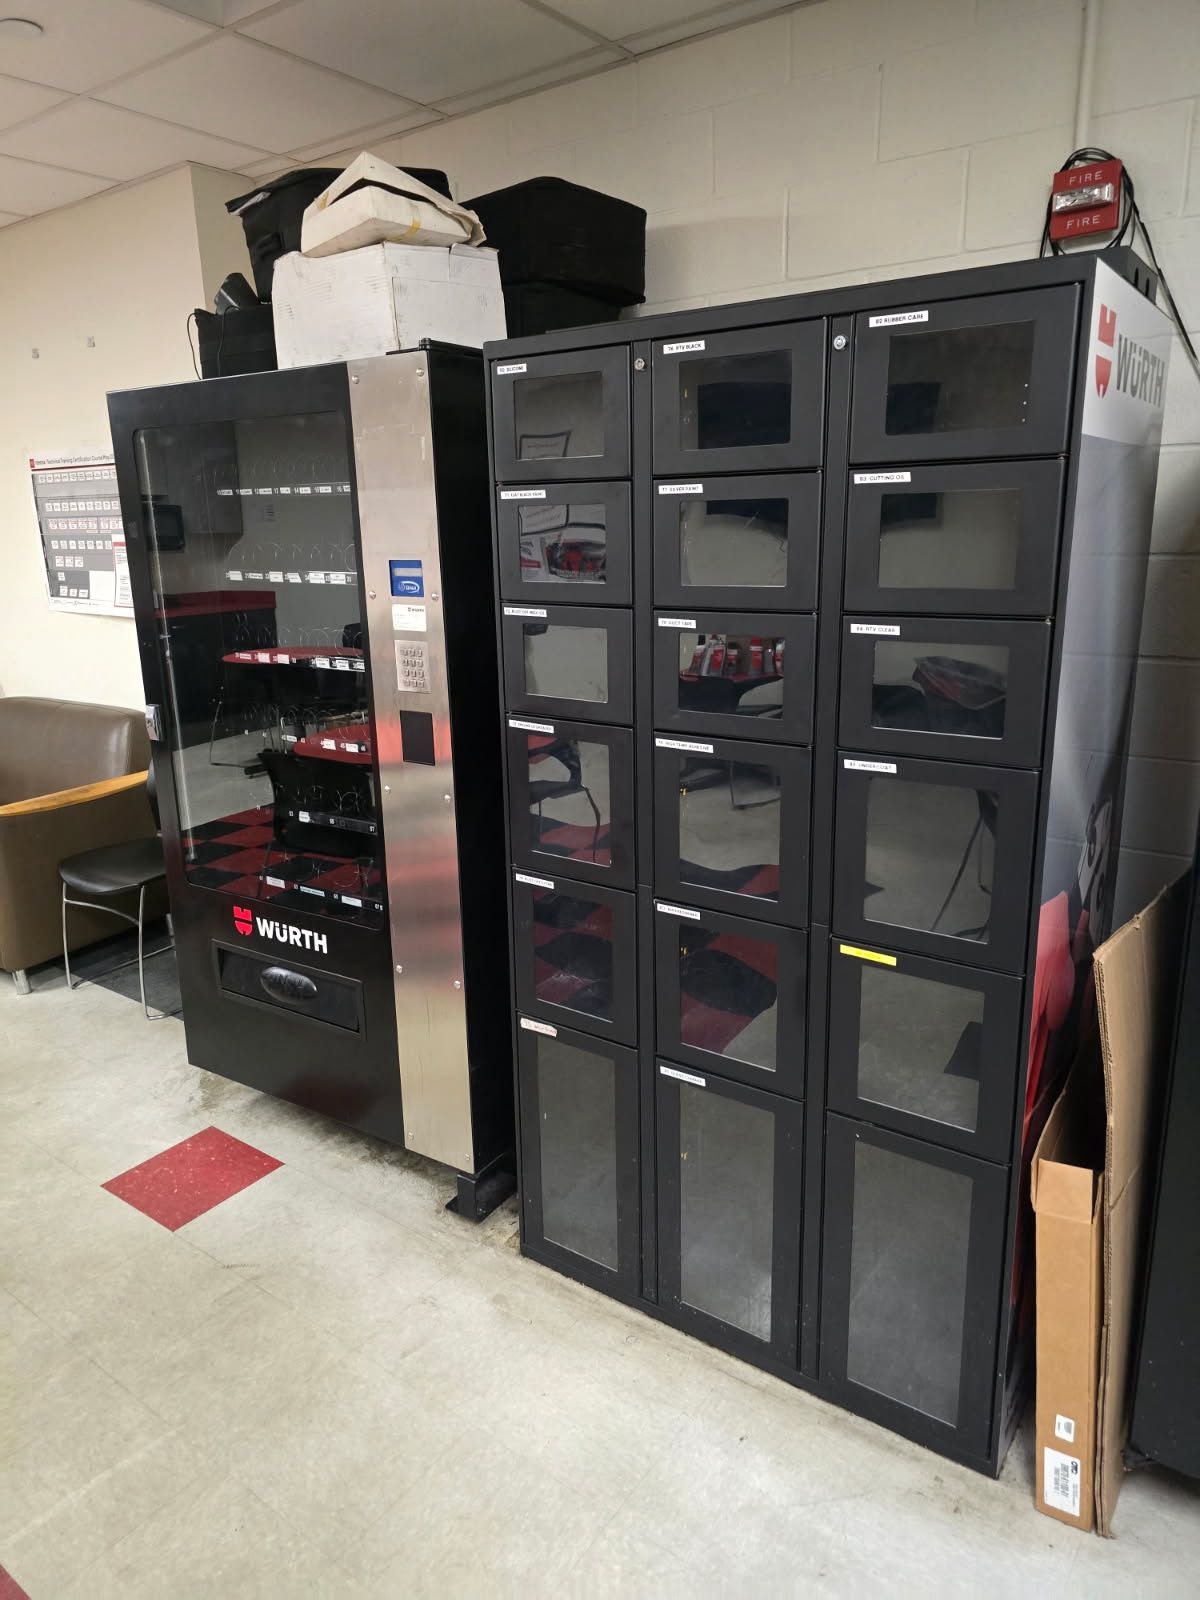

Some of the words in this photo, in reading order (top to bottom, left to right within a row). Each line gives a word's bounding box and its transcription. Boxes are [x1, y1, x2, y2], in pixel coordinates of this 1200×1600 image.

[1069, 170, 1104, 186] FIRE
[1066, 214, 1101, 229] FIRE
[883, 314, 907, 324] RUBBER
[907, 313, 924, 321] CARE
[1116, 335, 1165, 409] WÜRTH
[869, 474, 895, 482] CUTTING
[256, 917, 328, 954] WÜRTH
